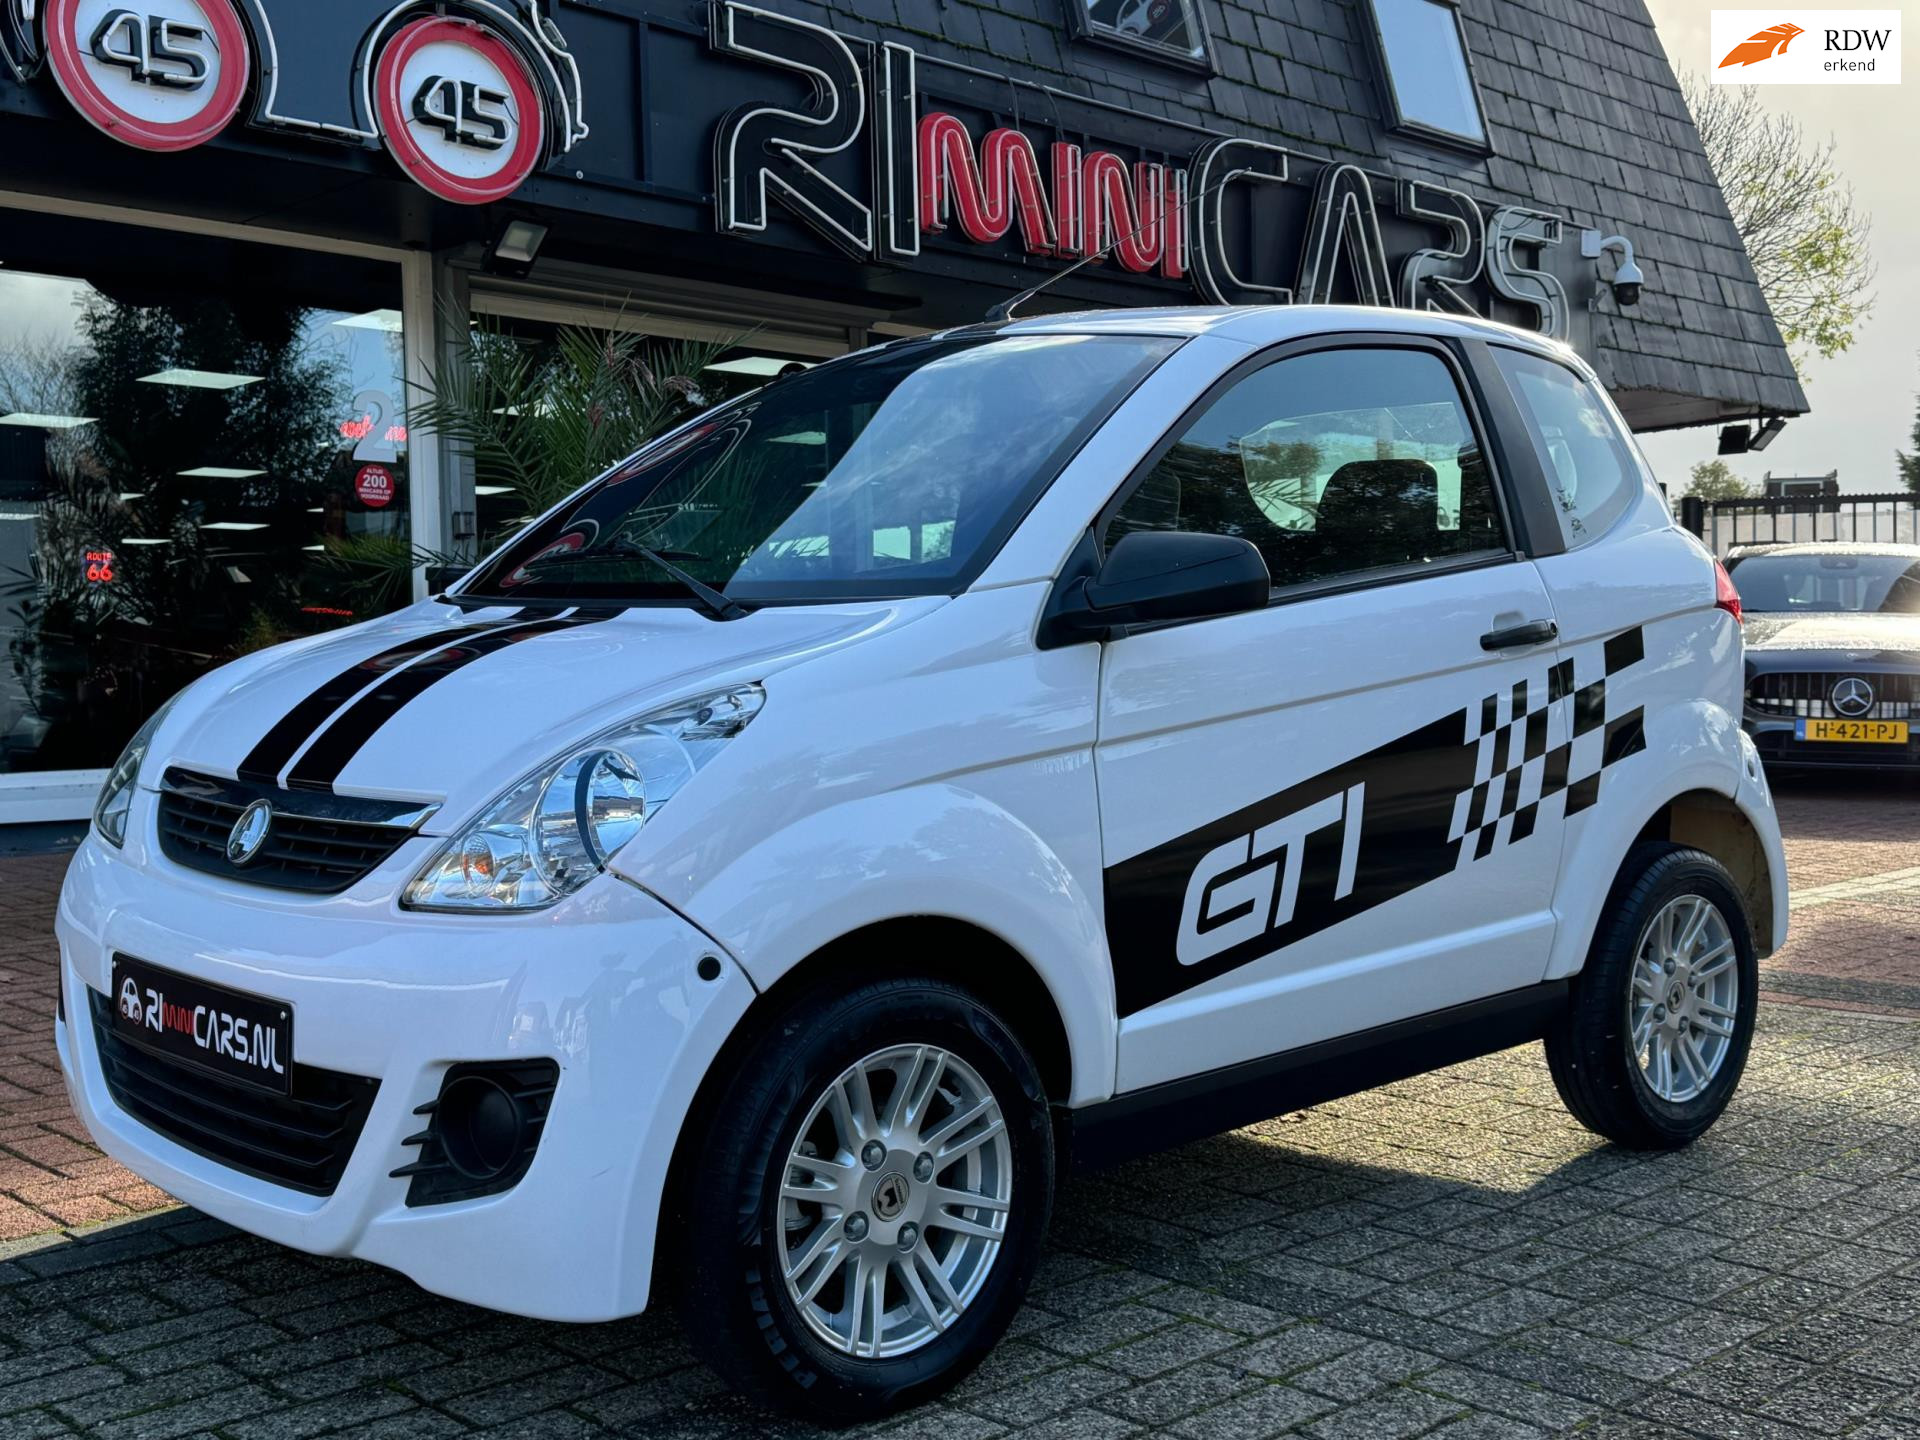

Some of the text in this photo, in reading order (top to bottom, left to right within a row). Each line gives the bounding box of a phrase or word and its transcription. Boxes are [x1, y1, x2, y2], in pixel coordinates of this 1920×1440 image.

[90, 8, 210, 90] 45
[412, 74, 514, 150] 45
[352, 389, 397, 463] 2
[362, 474, 388, 489] 200
[86, 551, 113, 562] ROUTE
[86, 562, 113, 581] 66
[1815, 722, 1898, 740] H-421-PJ
[1176, 781, 1366, 967] GTI
